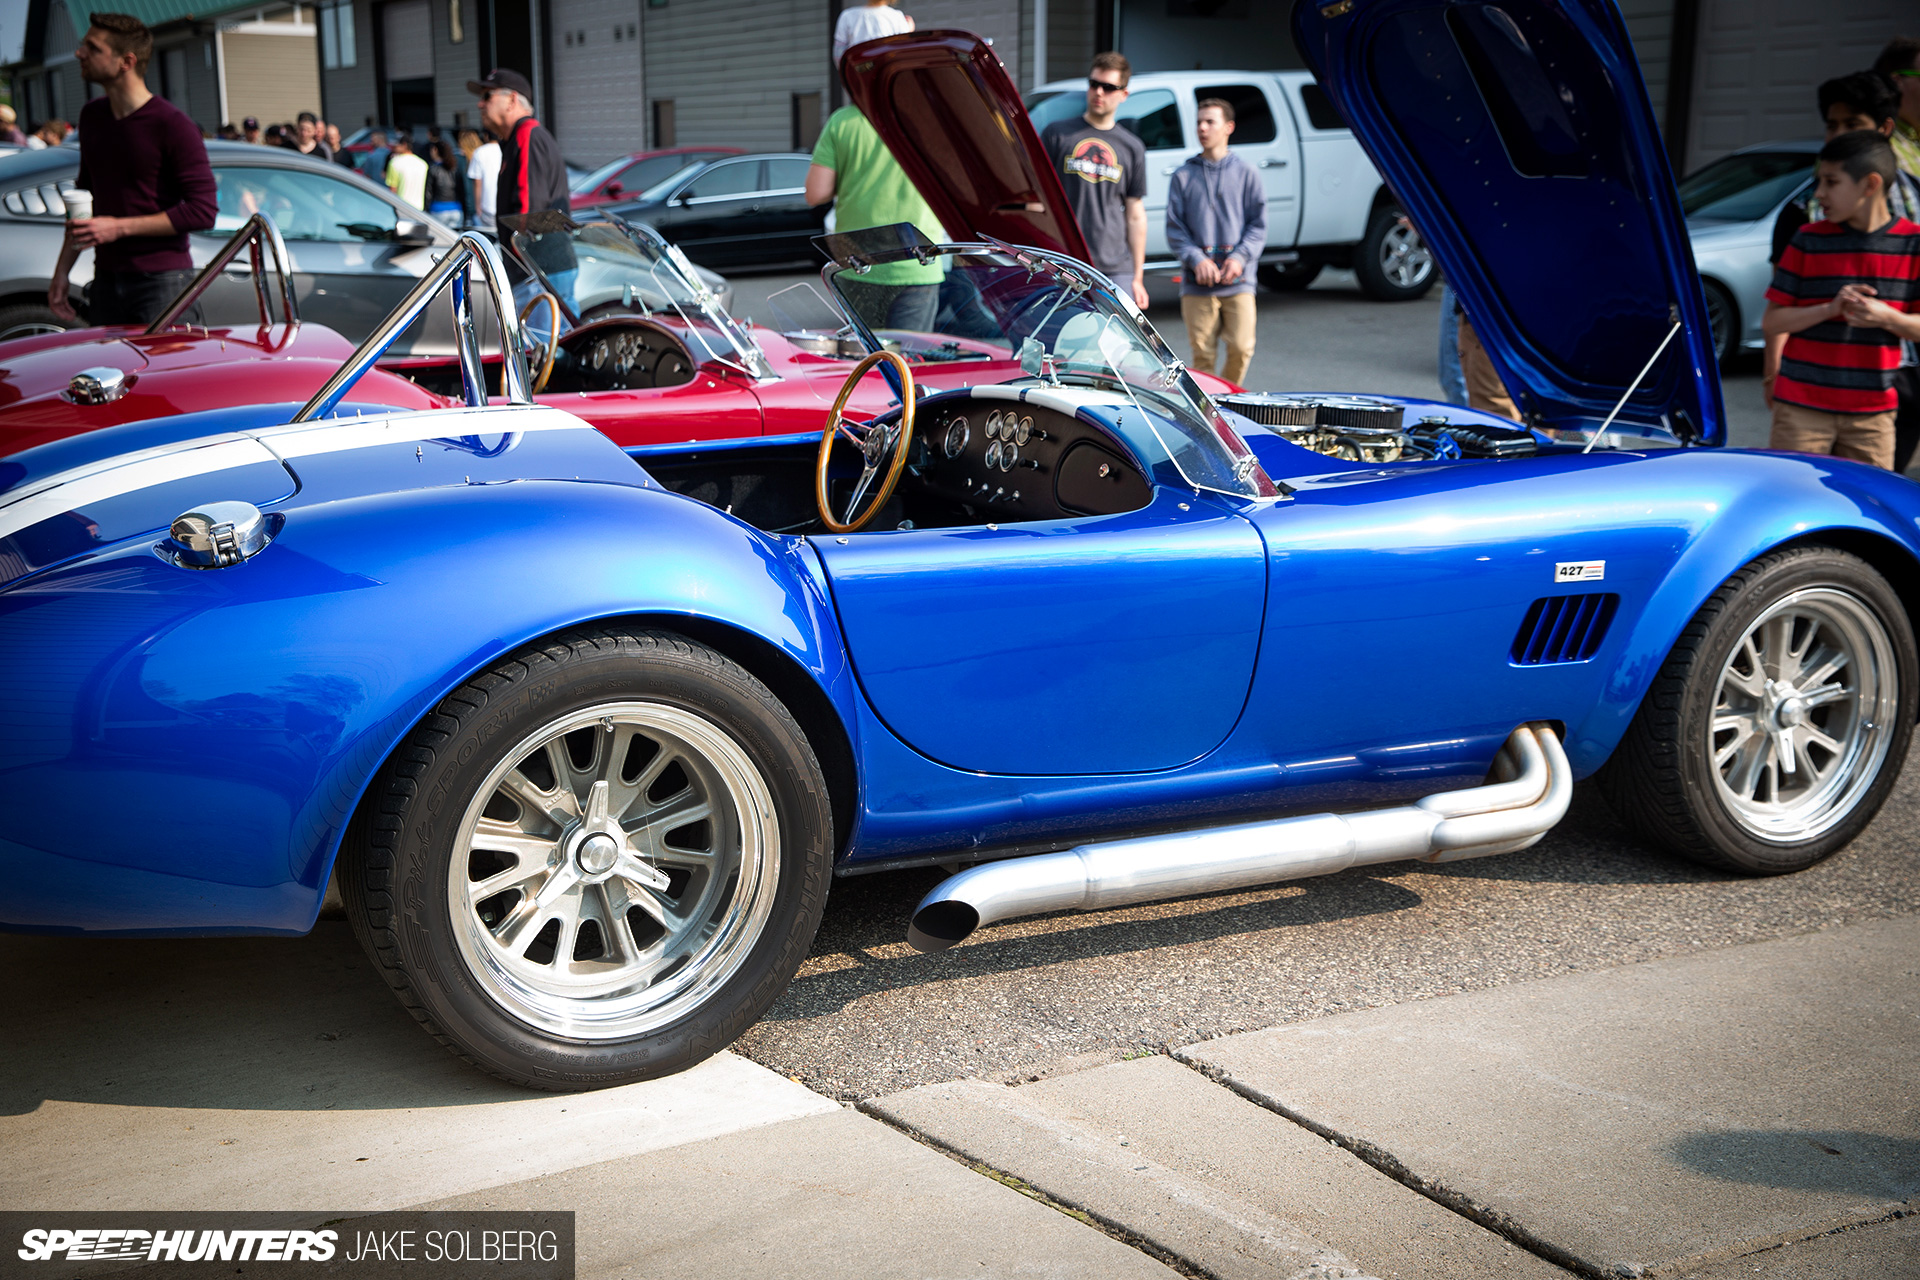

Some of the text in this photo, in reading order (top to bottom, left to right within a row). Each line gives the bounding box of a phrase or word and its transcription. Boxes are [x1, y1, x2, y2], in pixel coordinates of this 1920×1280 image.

[1560, 566, 1584, 576] 427
[402, 821, 435, 911] Pilot
[427, 698, 522, 817] SPORT
[687, 849, 823, 1060] MICHELIN
